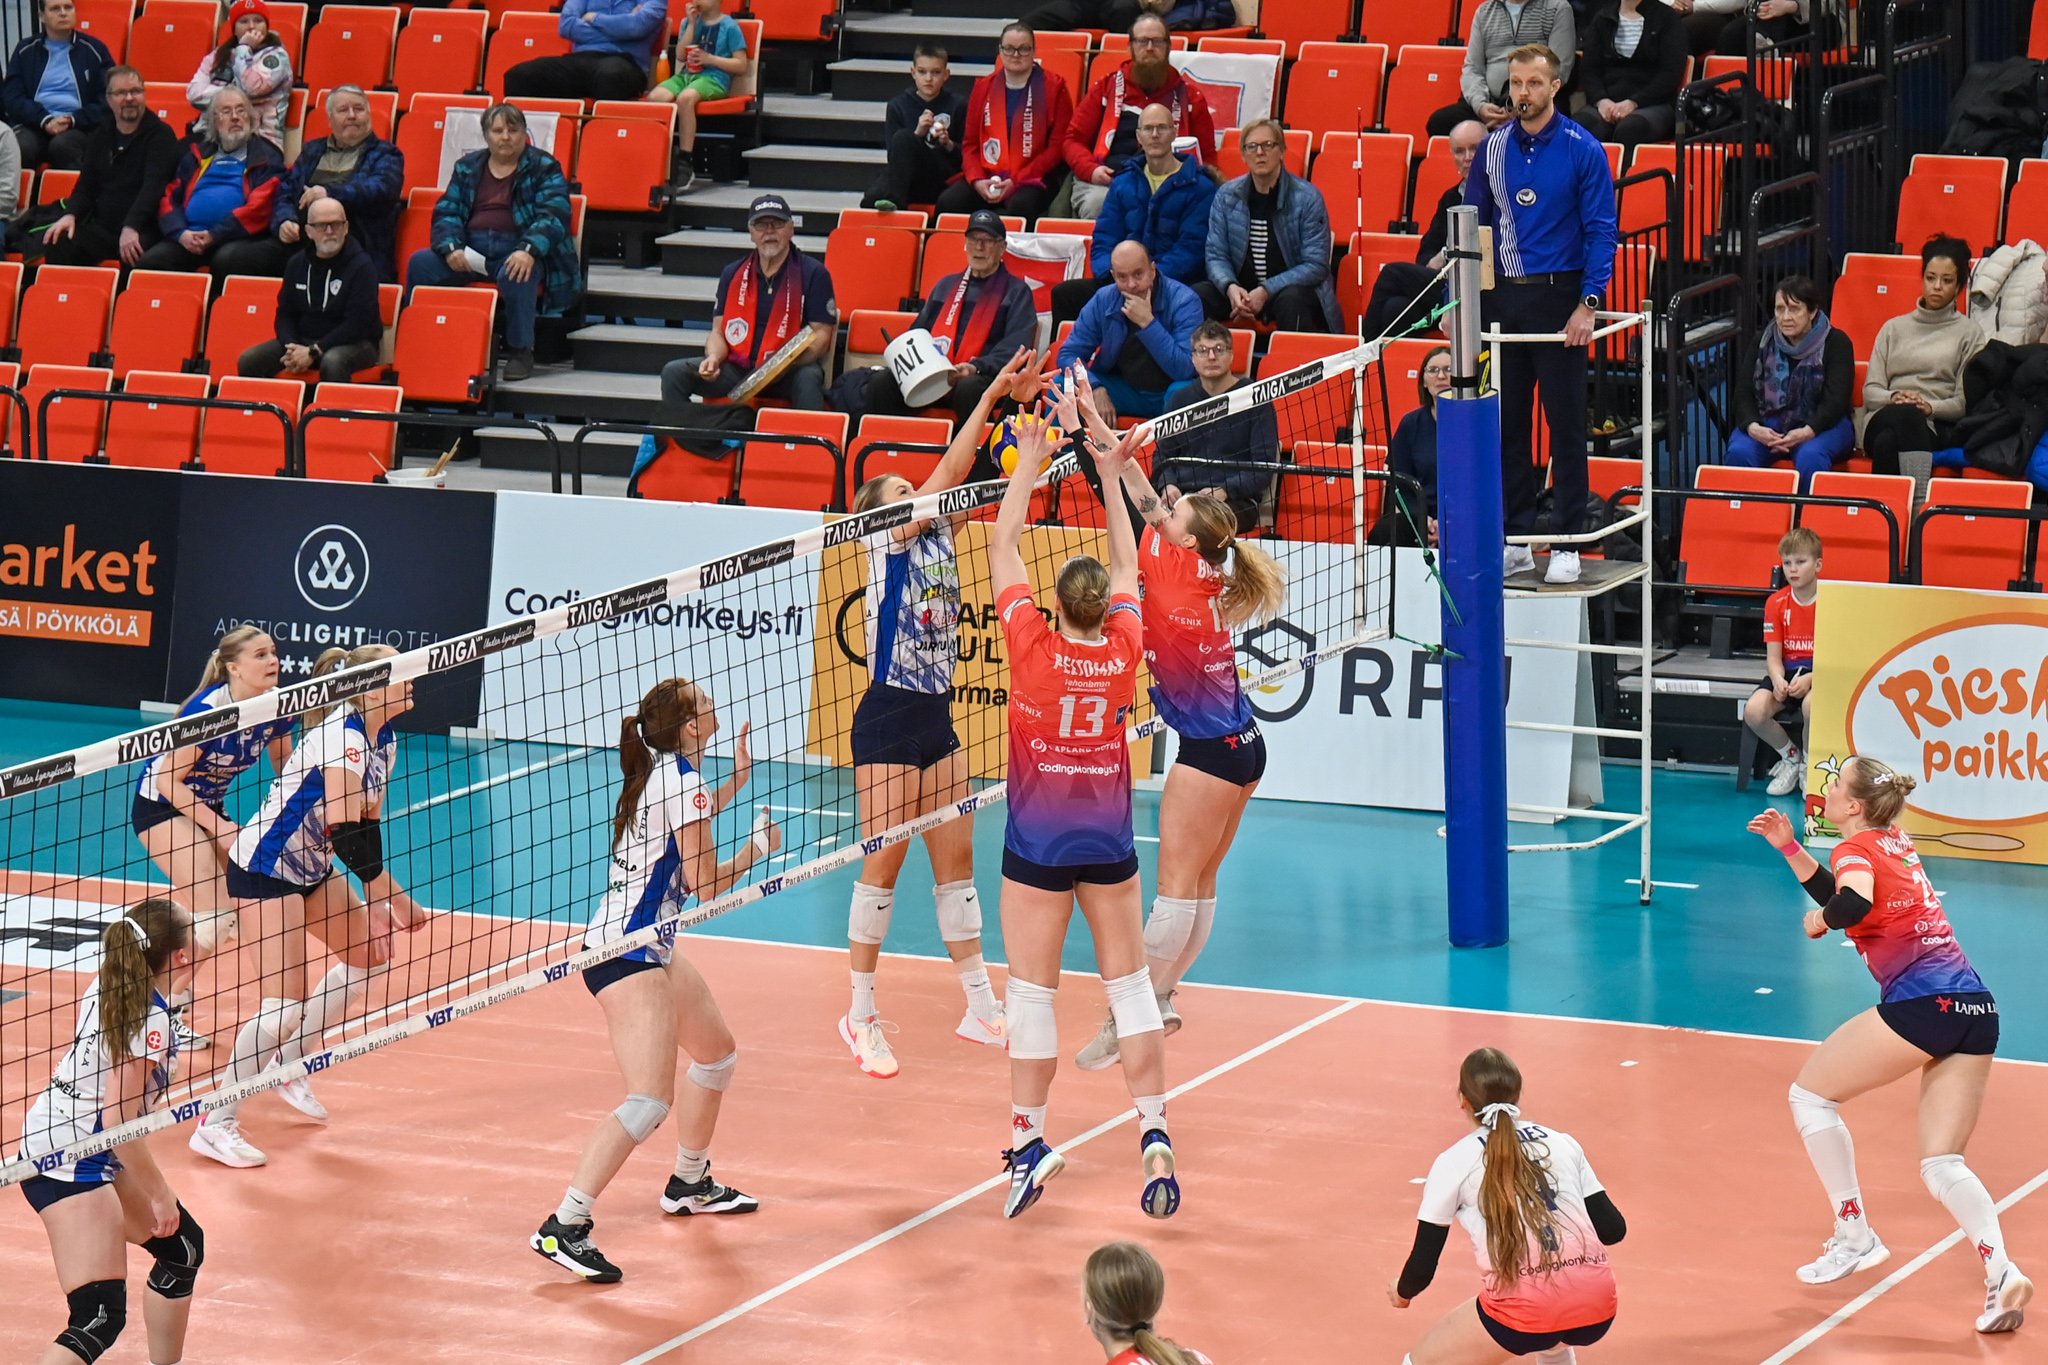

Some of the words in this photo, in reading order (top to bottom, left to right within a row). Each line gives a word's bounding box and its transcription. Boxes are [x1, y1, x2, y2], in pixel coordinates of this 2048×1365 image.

[755, 201, 783, 211] adidas
[1253, 378, 1287, 402] TAIGA
[1155, 414, 1190, 438] TAIGA
[1050, 458, 1082, 482] TAIG
[939, 488, 979, 512] TAIGA
[824, 520, 864, 546] TAIGA
[701, 557, 743, 586] TAIGA
[36, 609, 139, 637] PÖYKKÖLÄ
[569, 600, 613, 627] TAIGA
[213, 617, 439, 650] ARTICLIGHTHOTEL
[430, 638, 477, 669] TAIGA
[1299, 653, 1318, 670] YBT
[279, 683, 330, 715] TAIGA
[1058, 694, 1108, 738] 13
[1135, 721, 1157, 739] YBT
[120, 728, 175, 761] TAIGA
[1038, 762, 1121, 777] CodingMonkeys.fi
[956, 797, 979, 816] YBT
[979, 791, 1004, 807] Parasta
[861, 835, 884, 856] YBT
[885, 828, 910, 845] Parasta
[759, 876, 784, 897] YBT
[785, 871, 812, 887] Parasta
[653, 918, 680, 940] YBT
[680, 913, 708, 929] Parasta
[543, 961, 570, 983] YBT
[571, 955, 600, 972] Parasta
[425, 1007, 454, 1029] YBT
[455, 1000, 487, 1018] Parasta
[1955, 1000, 1986, 1016] LAPIN
[303, 1051, 333, 1075] YBT
[334, 1045, 367, 1064] Parasta
[171, 1100, 202, 1123] YBT
[204, 1093, 239, 1112] Parasta
[32, 1149, 66, 1173] YBT
[67, 1142, 105, 1163] Parasta
[1838, 1197, 1862, 1221] A
